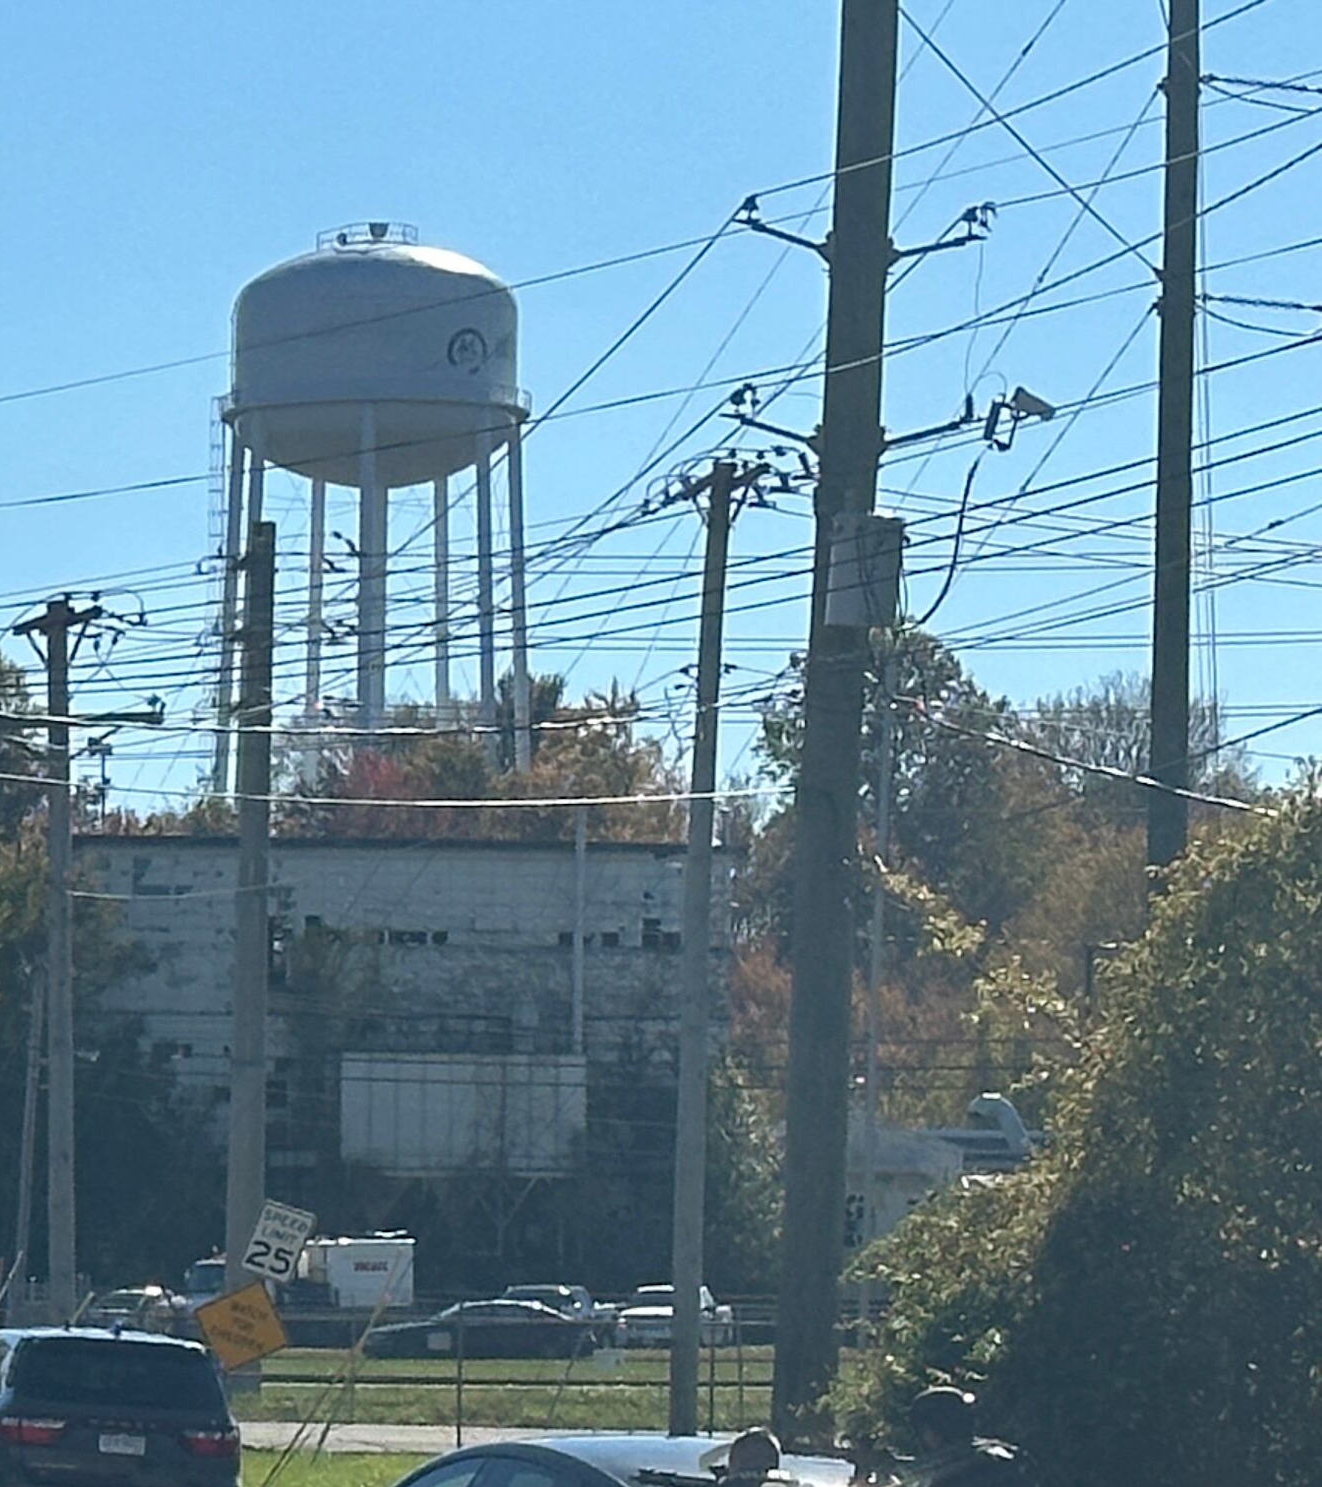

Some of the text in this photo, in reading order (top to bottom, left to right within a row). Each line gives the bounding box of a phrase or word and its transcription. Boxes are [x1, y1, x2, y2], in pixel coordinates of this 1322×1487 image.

[263, 1208, 308, 1233] SPEED
[261, 1226, 299, 1245] LIMIT
[245, 1240, 295, 1275] 25
